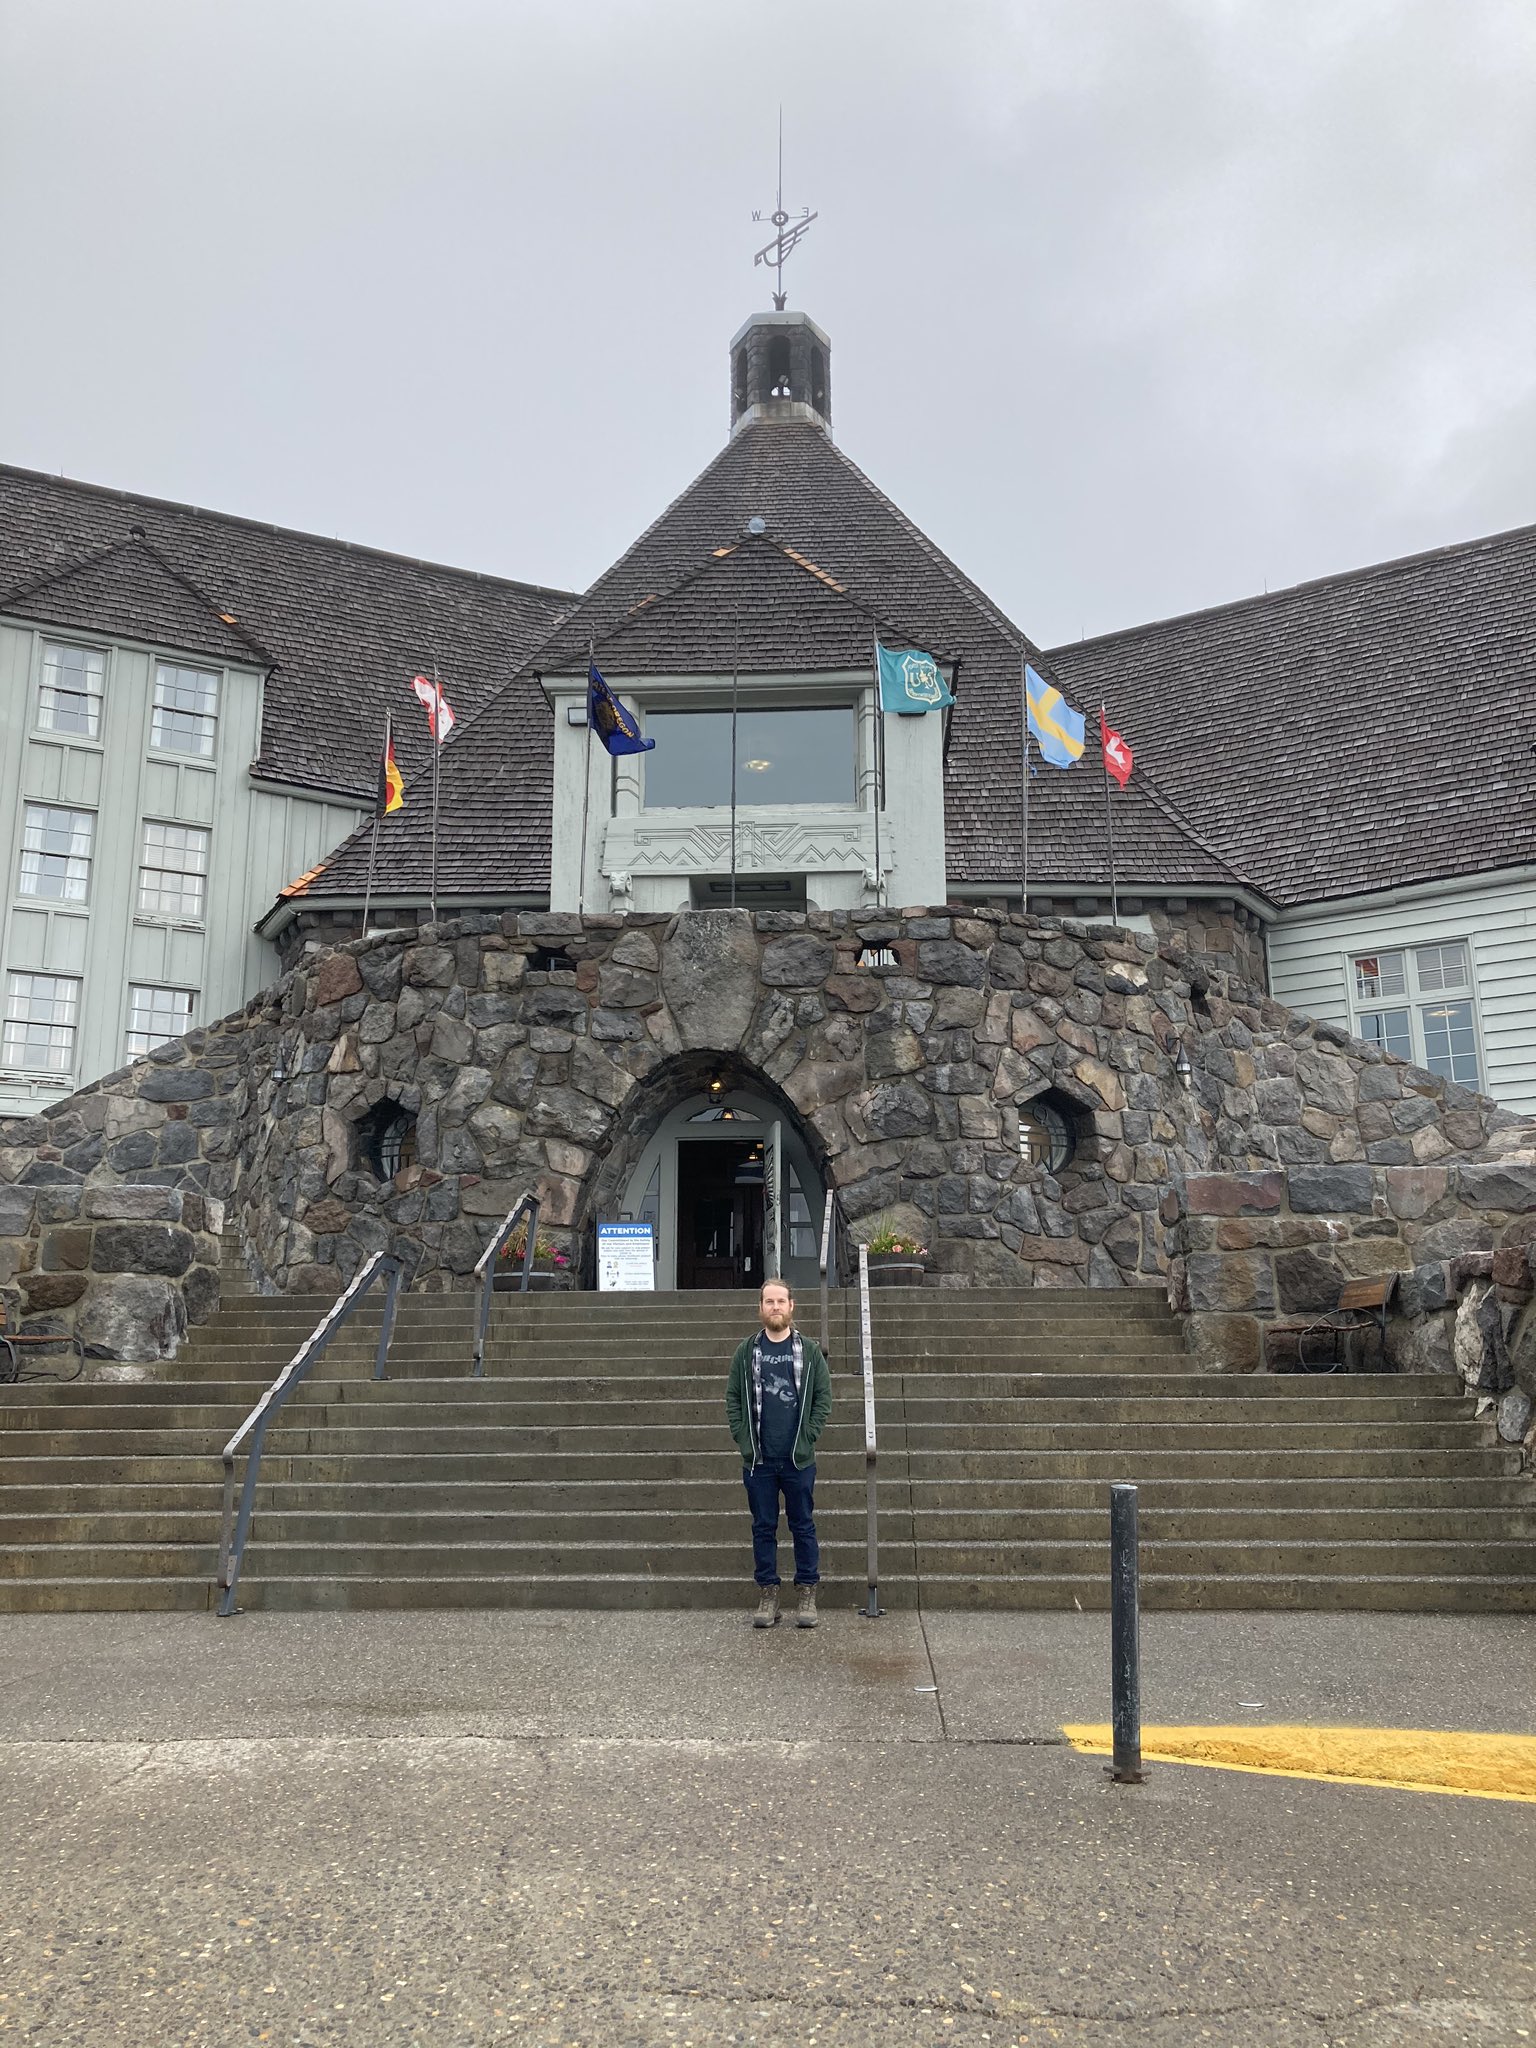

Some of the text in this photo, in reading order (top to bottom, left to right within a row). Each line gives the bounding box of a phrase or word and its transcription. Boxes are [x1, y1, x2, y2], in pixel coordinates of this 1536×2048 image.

[752, 210, 761, 221] W
[611, 704, 635, 738] OREGON
[600, 1227, 651, 1235] ATTENTION
